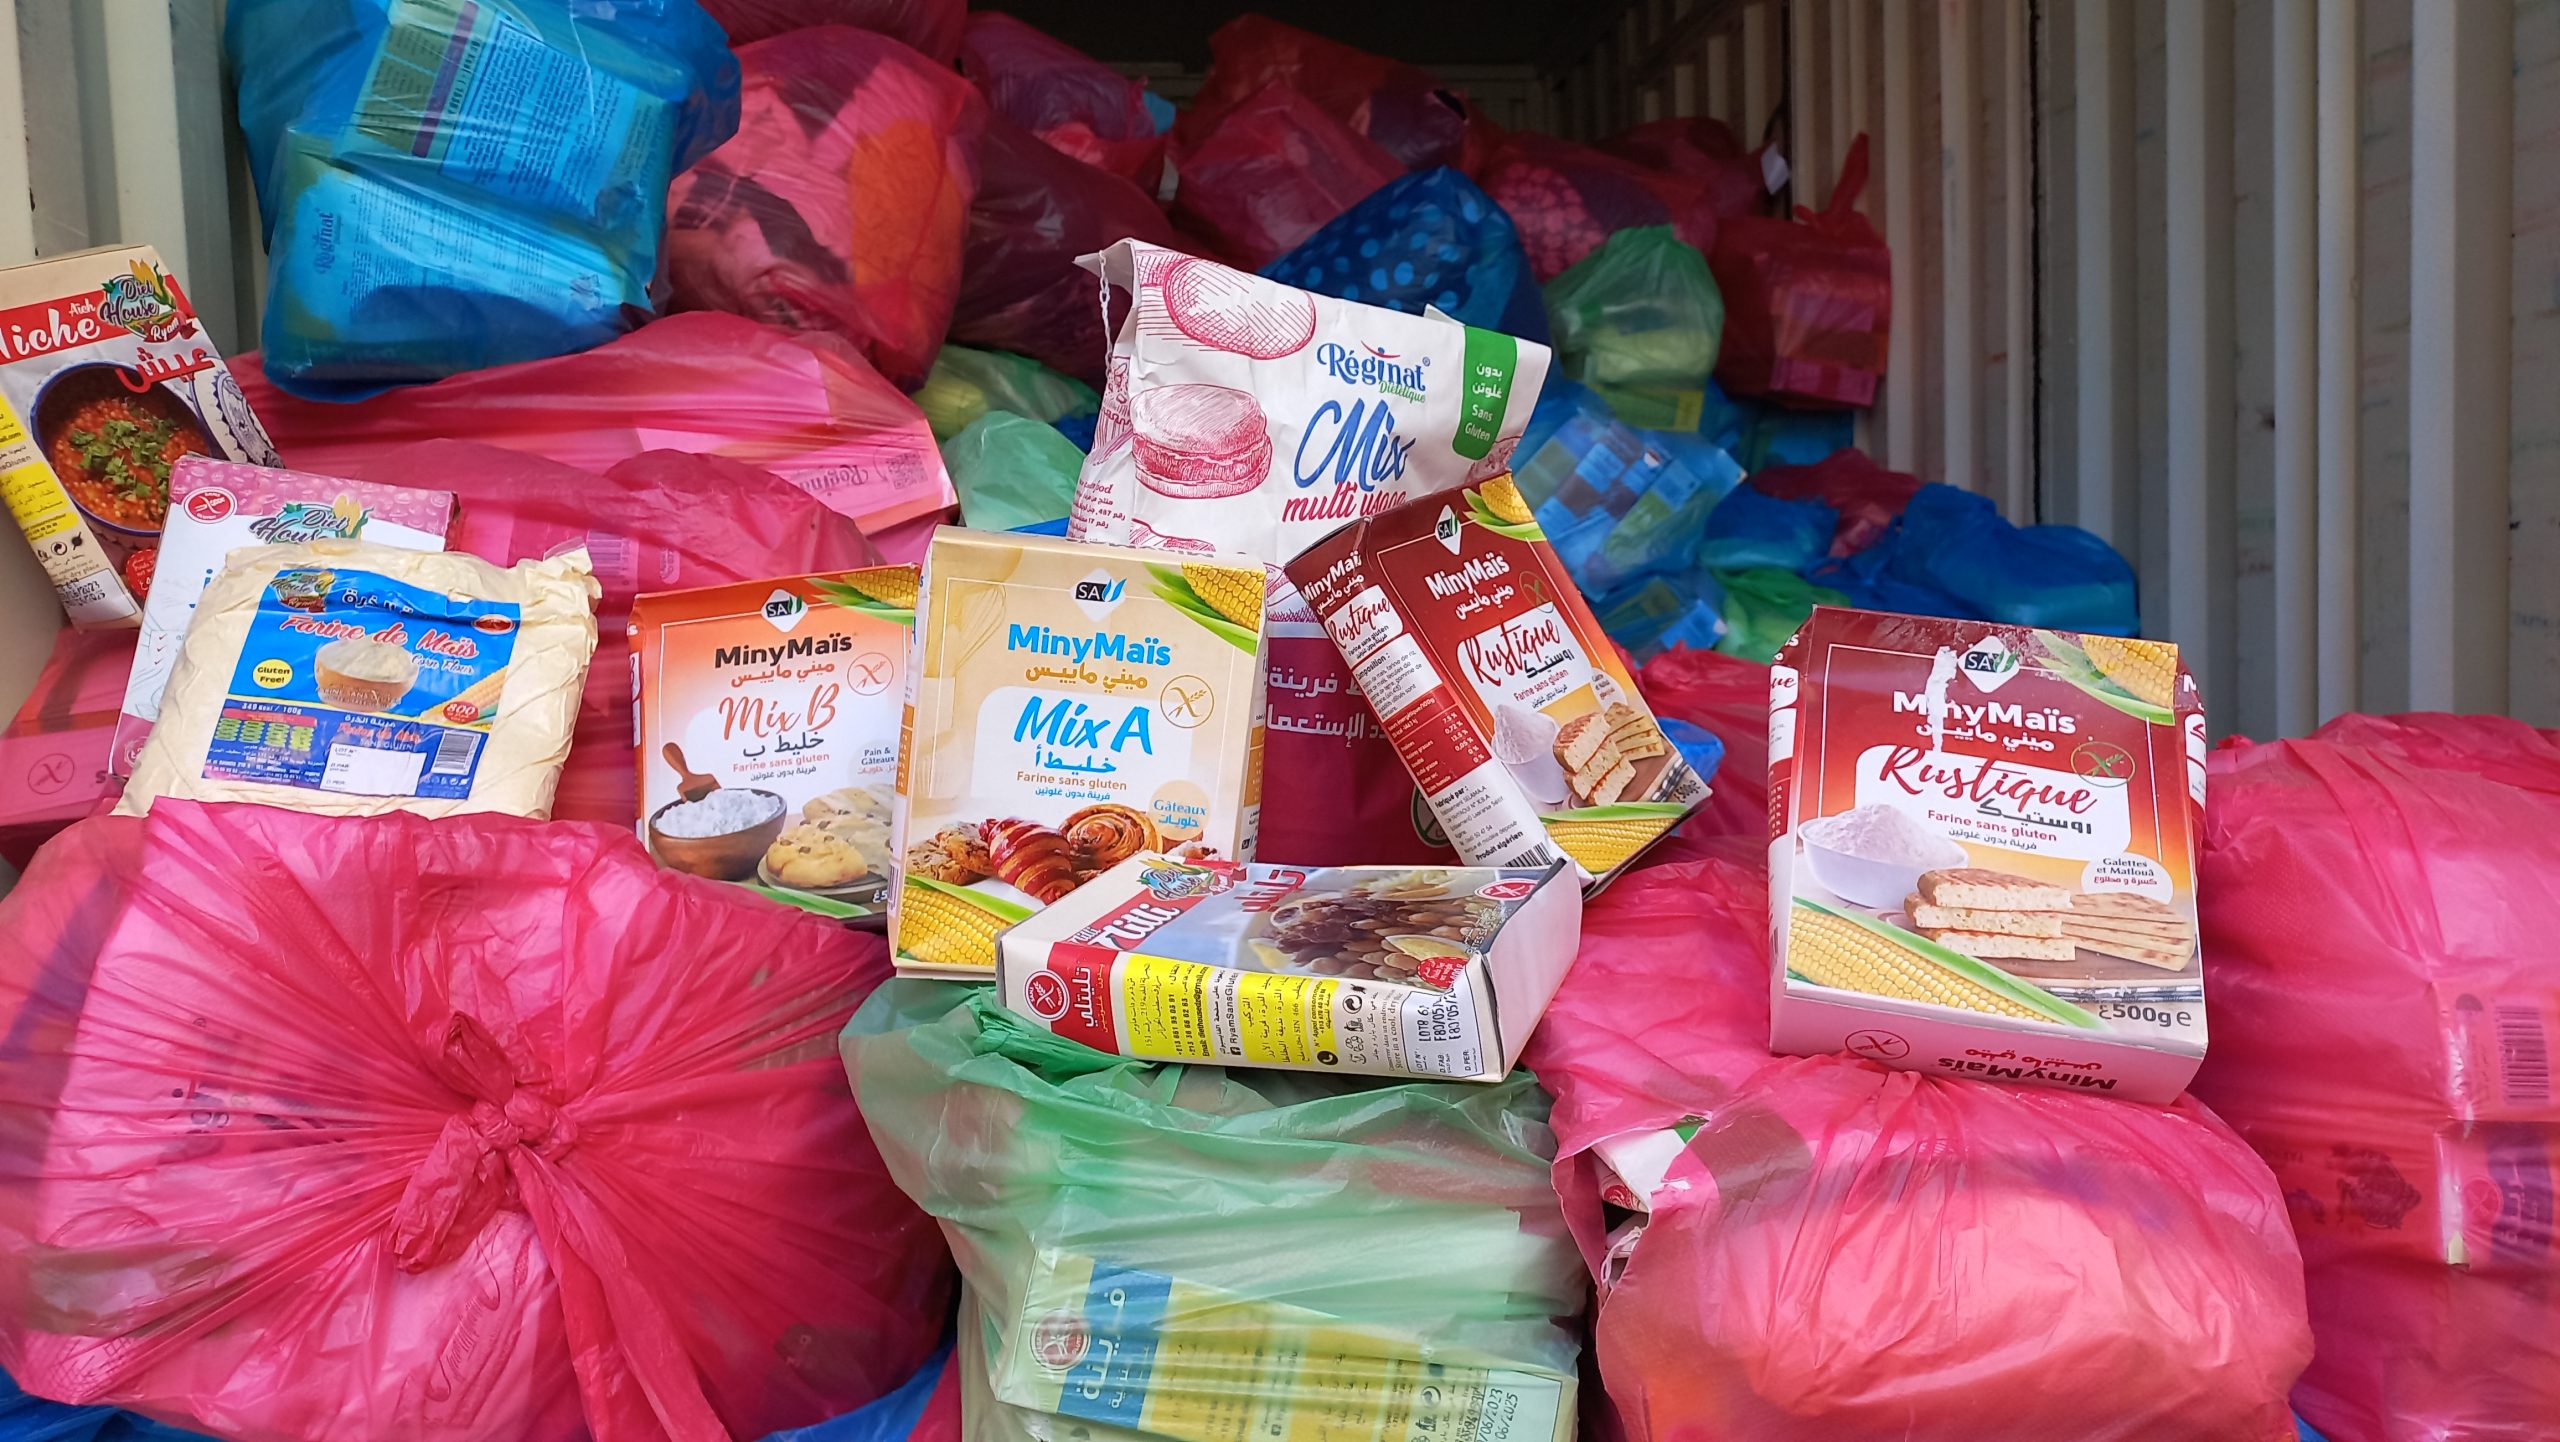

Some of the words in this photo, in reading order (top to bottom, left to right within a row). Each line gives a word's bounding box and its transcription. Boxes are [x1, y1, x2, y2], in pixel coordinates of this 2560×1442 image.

[122, 279, 154, 299] Diet
[100, 297, 159, 325] House
[1316, 341, 1427, 392] Réginat
[1475, 363, 1503, 379] بدون
[1472, 404, 1494, 422] Sans
[1464, 423, 1491, 442] Gluten
[1293, 398, 1418, 491] Mix
[1282, 481, 1358, 522] multi
[302, 509, 349, 531] Diet
[1424, 551, 1511, 602] MinyMaïs
[1489, 583, 1515, 608] ميني
[1326, 598, 1391, 650] Rustique
[1370, 624, 1390, 641] gluten
[280, 615, 365, 641] Farine
[372, 622, 408, 646] de
[418, 629, 479, 659] Maïs
[1007, 624, 1172, 667] MinyMaïs
[412, 653, 438, 669] Corn
[714, 632, 853, 669] MinyMaïs
[1465, 618, 1561, 687] Rustique
[257, 667, 291, 676] Gluten
[796, 661, 835, 681] ميني
[1025, 663, 1098, 685] ماييس
[1522, 648, 1575, 680] روستيك
[260, 676, 284, 684] Free!
[732, 666, 792, 687] ماييس
[1103, 673, 1148, 693] ميني
[1269, 666, 1338, 698] فرينة
[1513, 685, 1536, 702] Farine
[1534, 679, 1551, 694] sans
[1549, 668, 1570, 687] gluten
[446, 701, 476, 715] 800
[718, 696, 800, 740] Mix
[806, 683, 840, 731] B
[1013, 696, 1110, 749] Mix
[1110, 706, 1154, 755] A
[1267, 704, 1365, 748] الإستعما
[743, 746, 766, 759] ب
[774, 729, 824, 757] خليط
[864, 748, 882, 757] Pain
[883, 747, 891, 755] &
[2002, 732, 2054, 752] ميني
[733, 760, 765, 773] Farine
[769, 757, 793, 767] sans
[796, 752, 830, 767] gluten
[861, 754, 895, 766] Gâteaux
[1042, 754, 1117, 776] خليط
[1017, 770, 1055, 785] Farine
[1058, 776, 1086, 789] sans
[1088, 778, 1128, 794] gluten
[1879, 744, 2097, 814] Rustique
[1035, 786, 1063, 798] غلوتين
[1065, 791, 1086, 801] بدون
[1087, 790, 1111, 801] فرينة
[1453, 787, 1466, 798] par
[1154, 799, 1207, 817] Gâteaux
[1976, 798, 2093, 835] روستيك
[1158, 815, 1199, 830] حلويات
[1928, 810, 1972, 827] Farine
[1976, 818, 2008, 833] sans
[2011, 824, 2058, 843] gluten
[1475, 845, 1498, 862] Produit
[1495, 830, 1525, 850] algérien
[1983, 834, 2007, 847] بدون
[2009, 838, 2038, 852] فرينة
[2103, 857, 2148, 868] Galettes
[2110, 867, 2154, 877] Matlouâ
[1071, 967, 1095, 1028] تليتلي
[1937, 1056, 2117, 1091] MinyMaïs
